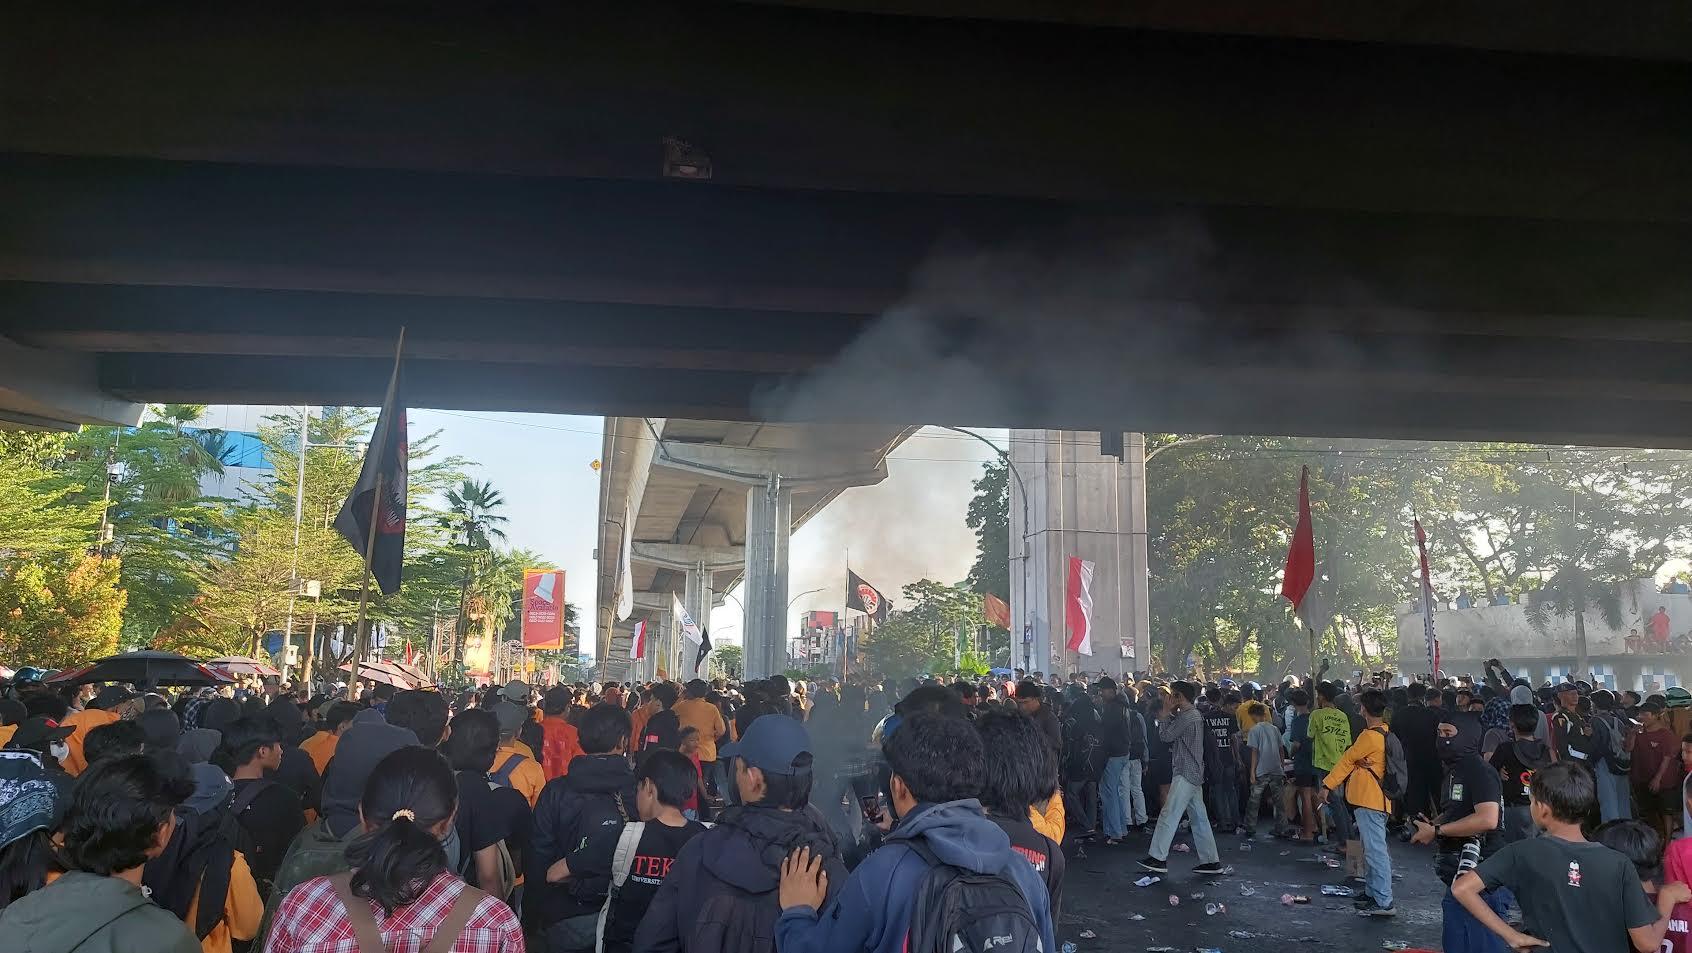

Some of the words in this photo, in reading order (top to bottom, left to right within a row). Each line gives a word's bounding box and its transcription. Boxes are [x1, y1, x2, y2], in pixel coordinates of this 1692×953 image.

[1210, 717, 1230, 726] WANT
[1322, 726, 1348, 736] STYLE
[631, 874, 663, 886] UNIVERSIT
